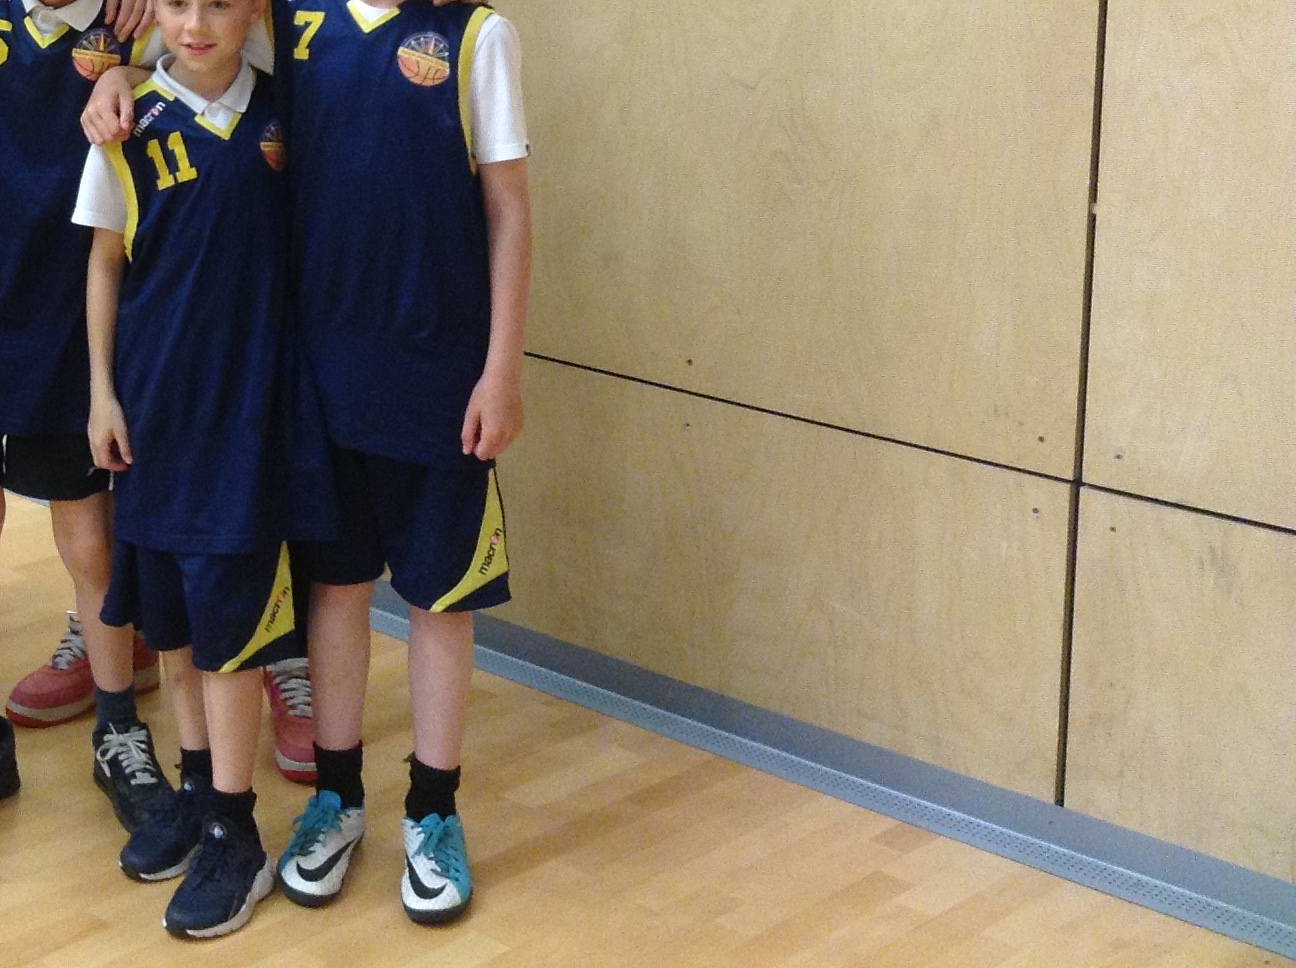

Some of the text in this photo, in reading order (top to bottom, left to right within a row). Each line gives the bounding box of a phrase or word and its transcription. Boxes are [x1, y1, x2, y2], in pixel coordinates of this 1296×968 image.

[293, 10, 325, 60] 7
[133, 102, 165, 137] macron
[146, 131, 198, 191] 11
[478, 528, 503, 575] macron
[265, 586, 290, 633] macron
